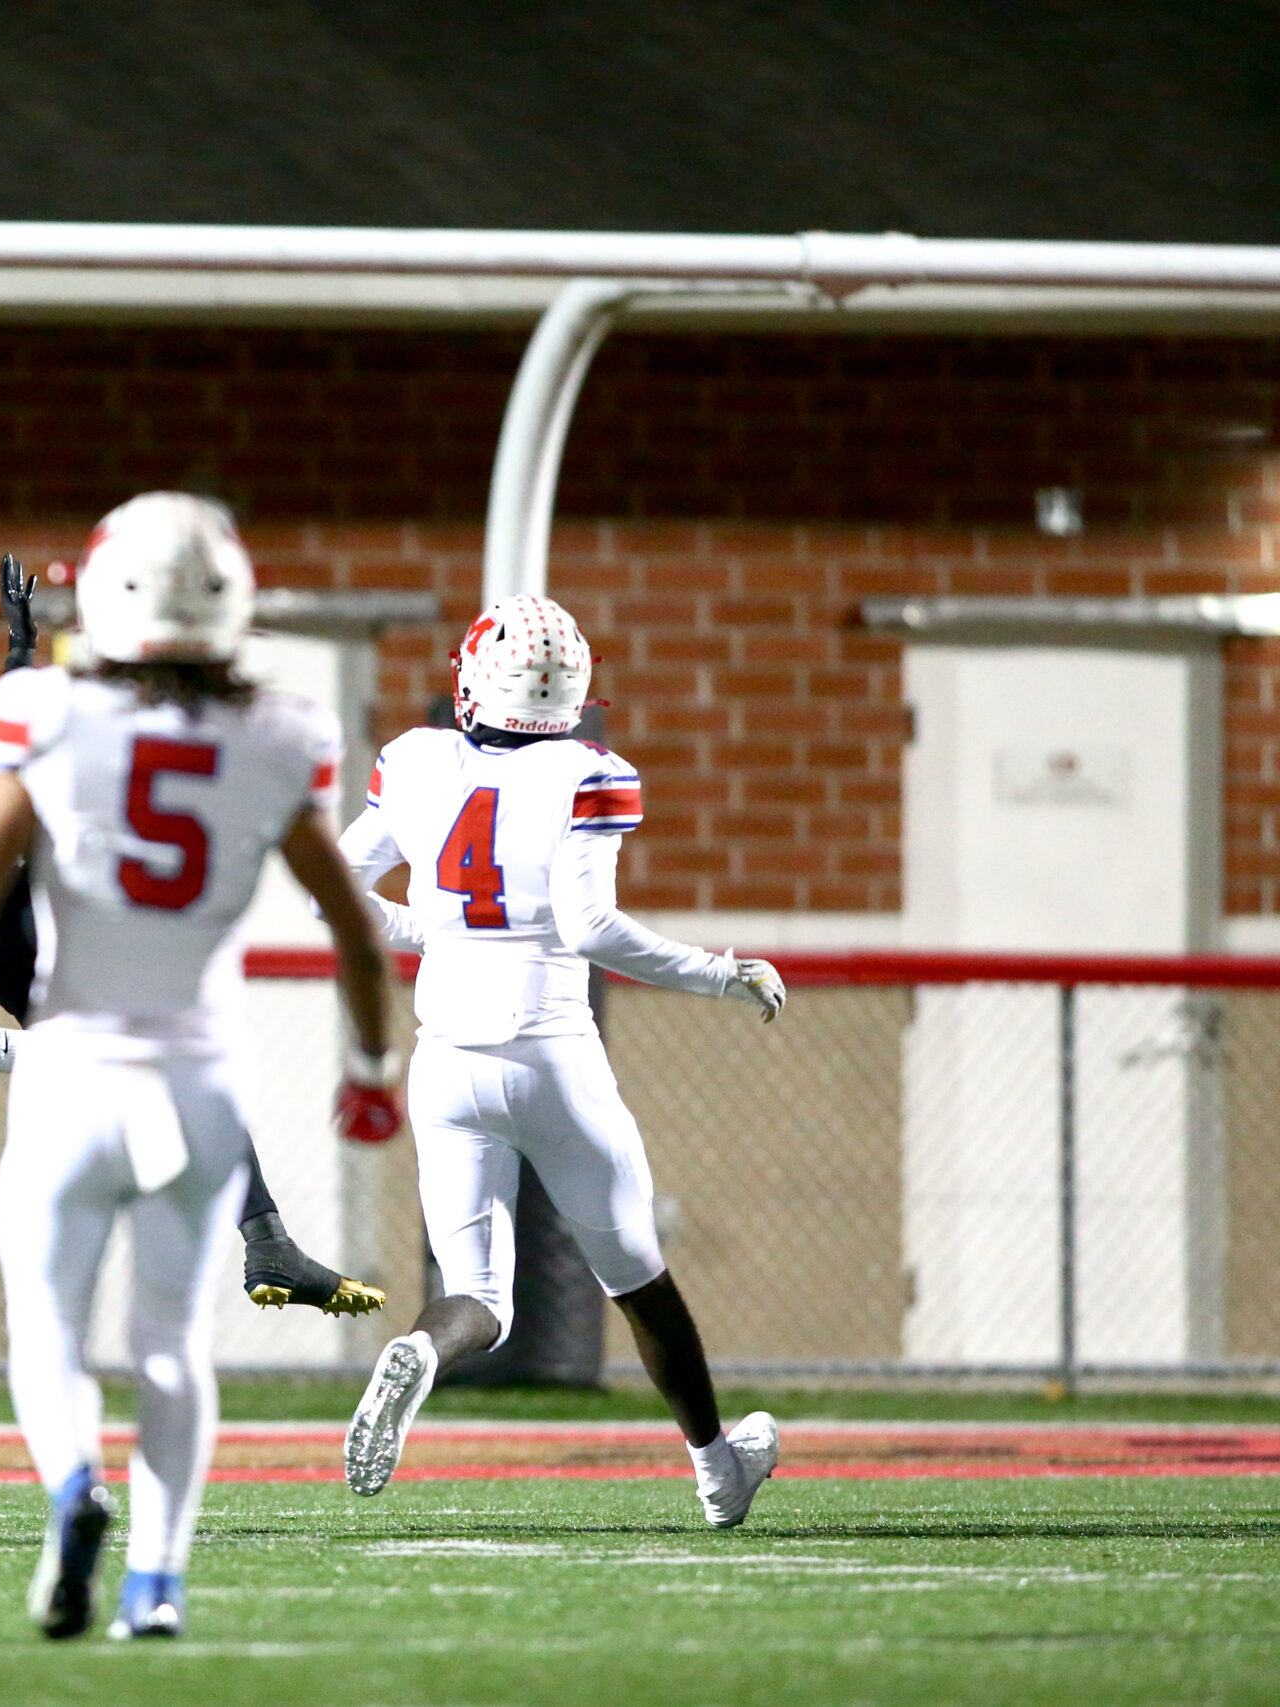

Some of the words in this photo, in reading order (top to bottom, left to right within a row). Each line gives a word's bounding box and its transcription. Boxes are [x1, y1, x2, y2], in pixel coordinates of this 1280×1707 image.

[540, 671, 550, 685] 4
[504, 717, 569, 733] Riddell
[117, 732, 224, 912] 5
[436, 786, 510, 930] 4
